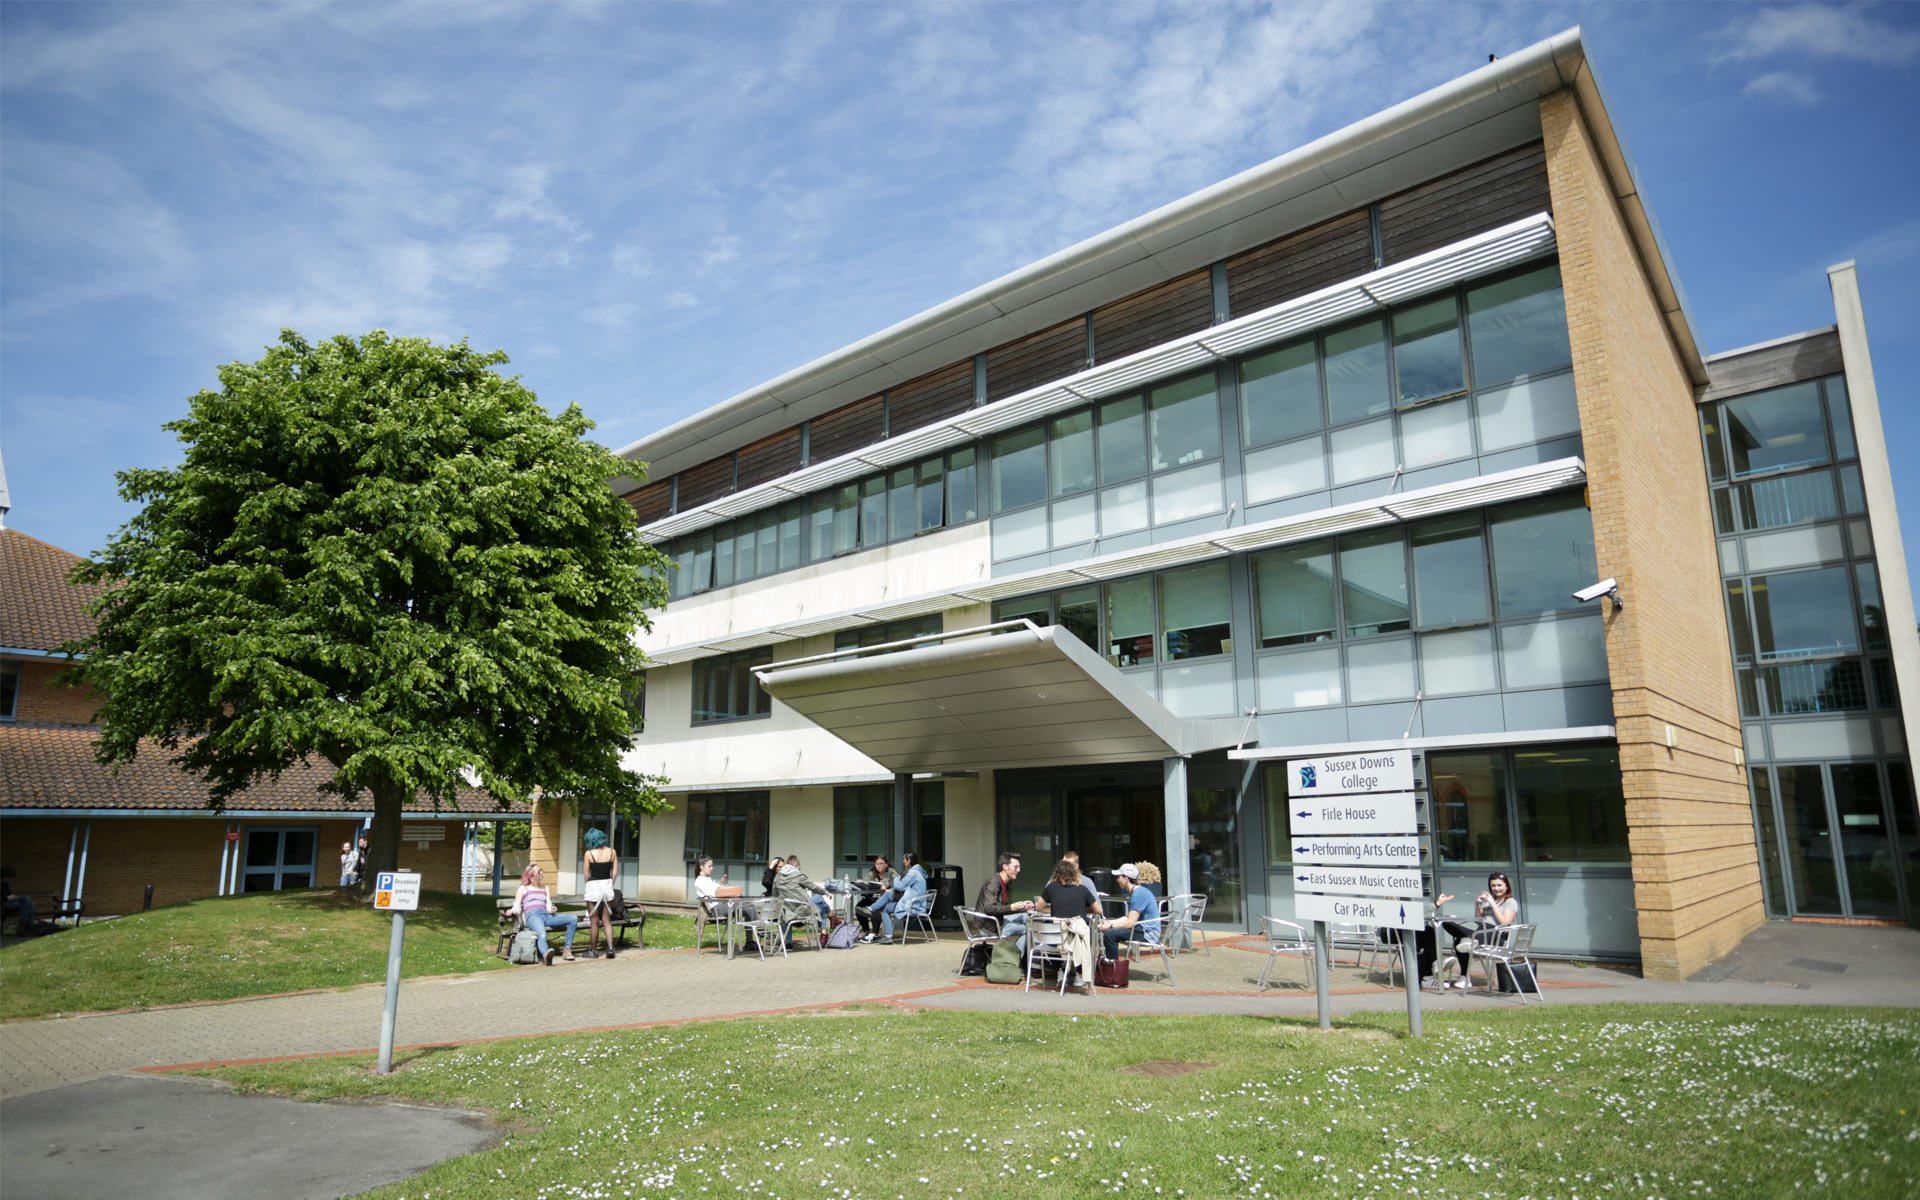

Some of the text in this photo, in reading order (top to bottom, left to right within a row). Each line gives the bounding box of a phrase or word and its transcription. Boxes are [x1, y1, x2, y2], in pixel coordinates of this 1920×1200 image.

[1324, 756, 1395, 773] Sussex Downs
[1341, 774, 1378, 790] College
[1322, 807, 1376, 820] Firle House
[1312, 842, 1417, 859] Performing Arts Centre
[381, 876, 392, 889] P
[1310, 873, 1419, 889] East Sussex Music Centre
[1334, 902, 1375, 918] Car Park
